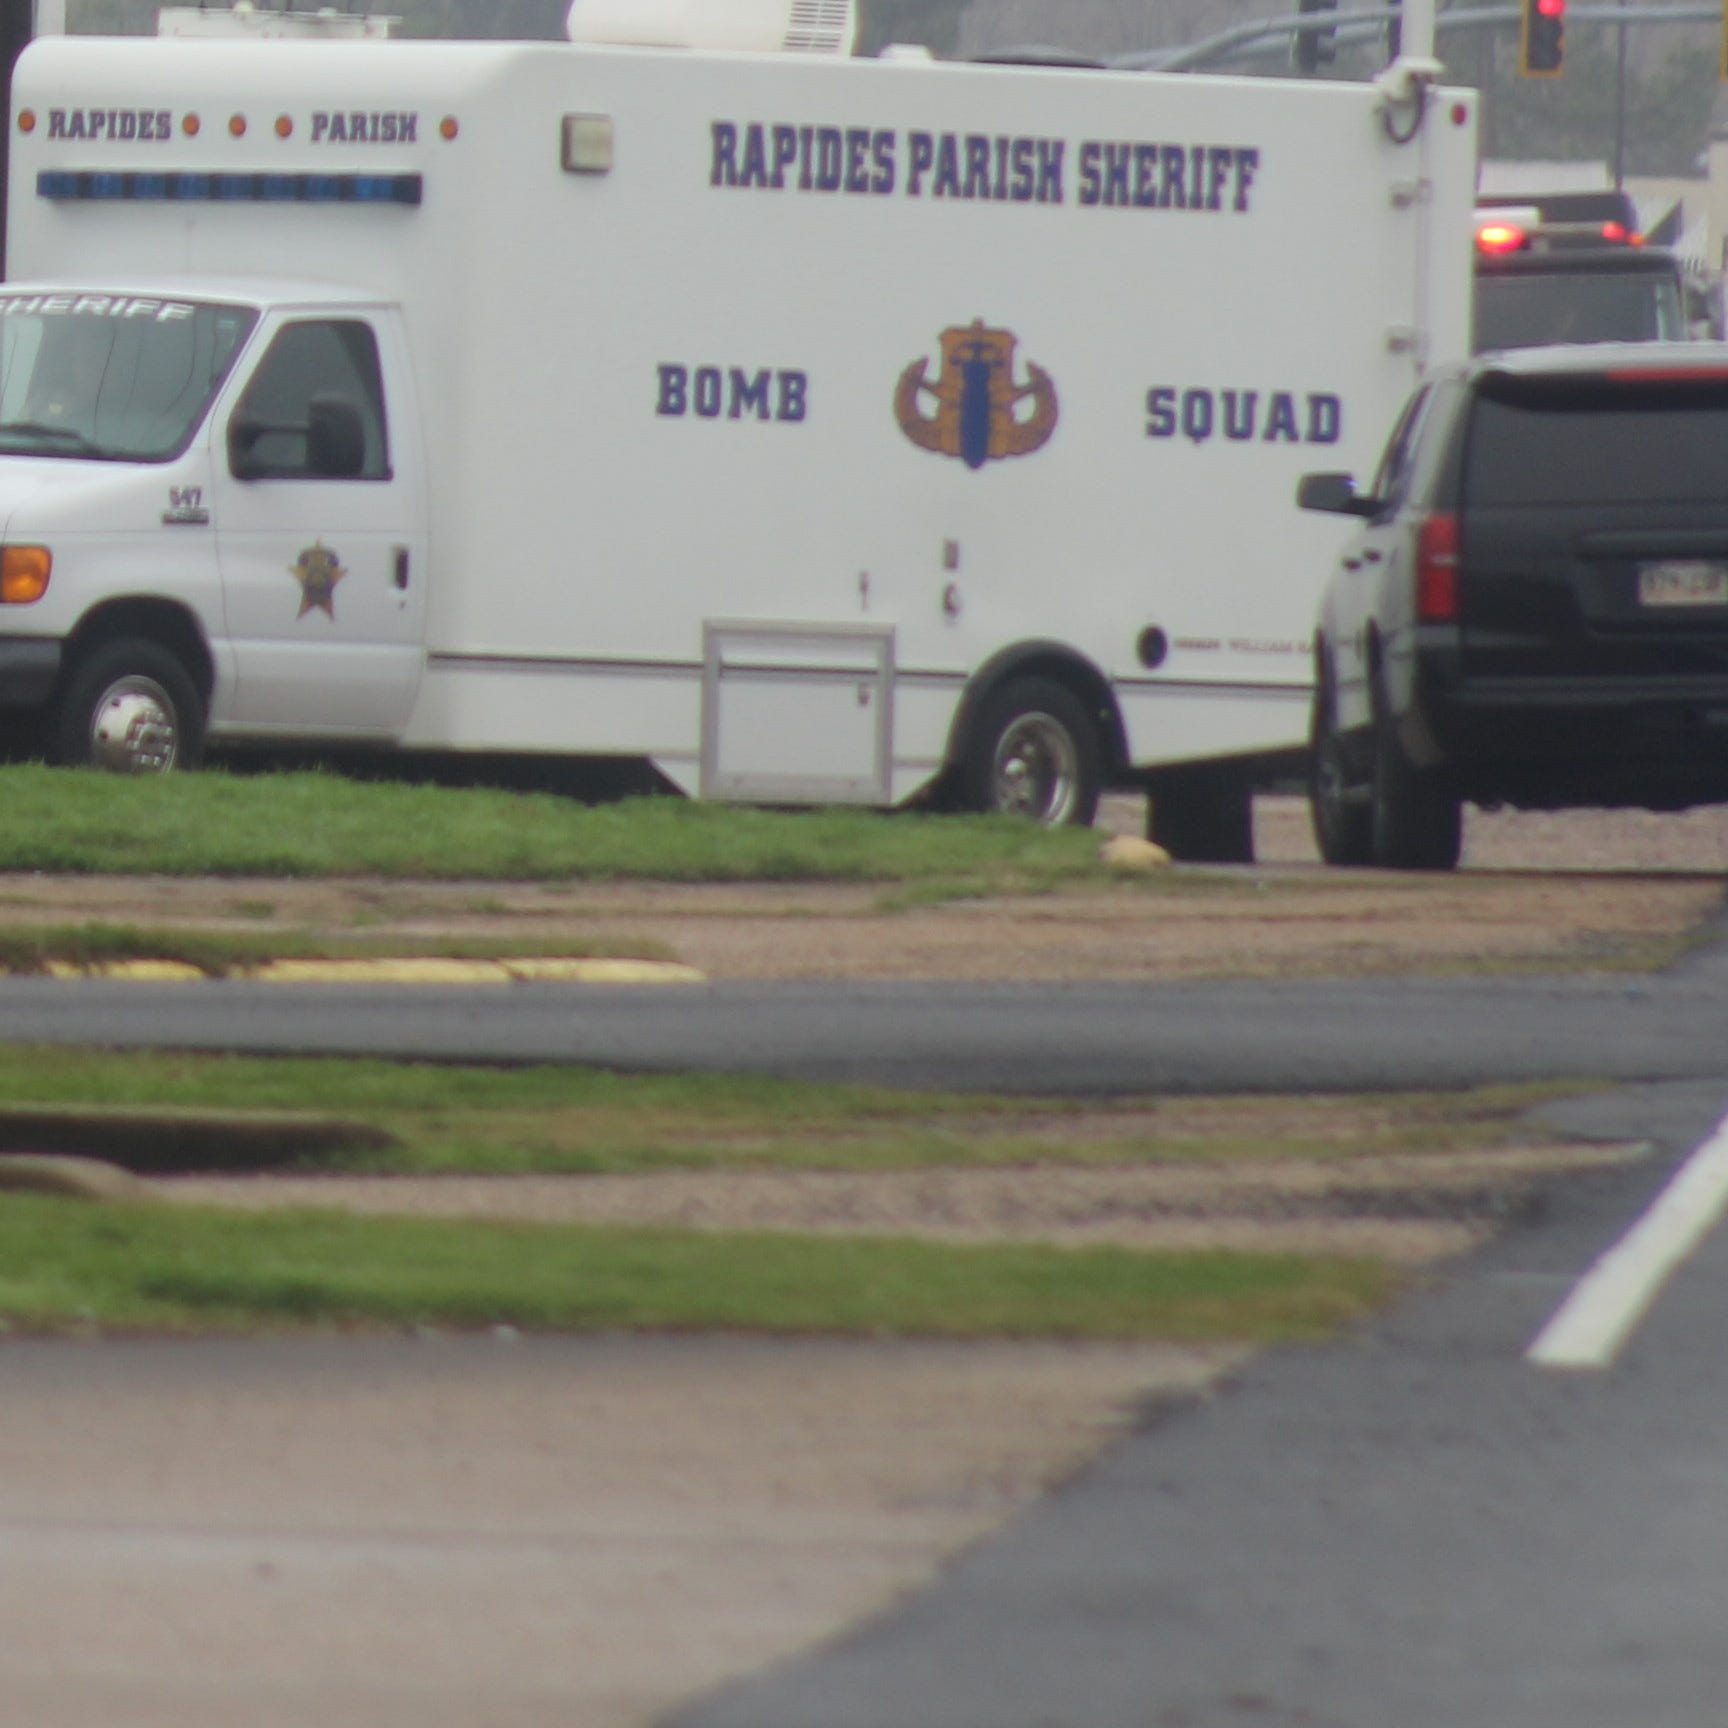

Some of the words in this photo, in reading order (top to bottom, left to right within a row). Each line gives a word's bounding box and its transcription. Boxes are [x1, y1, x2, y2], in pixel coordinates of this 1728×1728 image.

[48, 110, 172, 140] RAPIDES
[311, 112, 417, 143] PARISH
[711, 122, 896, 196] RAPIDES
[907, 132, 1065, 204] PARISH
[1079, 143, 1259, 213] SHERIFF
[656, 363, 808, 423] BOMB
[1146, 386, 1342, 445] SQUAD
